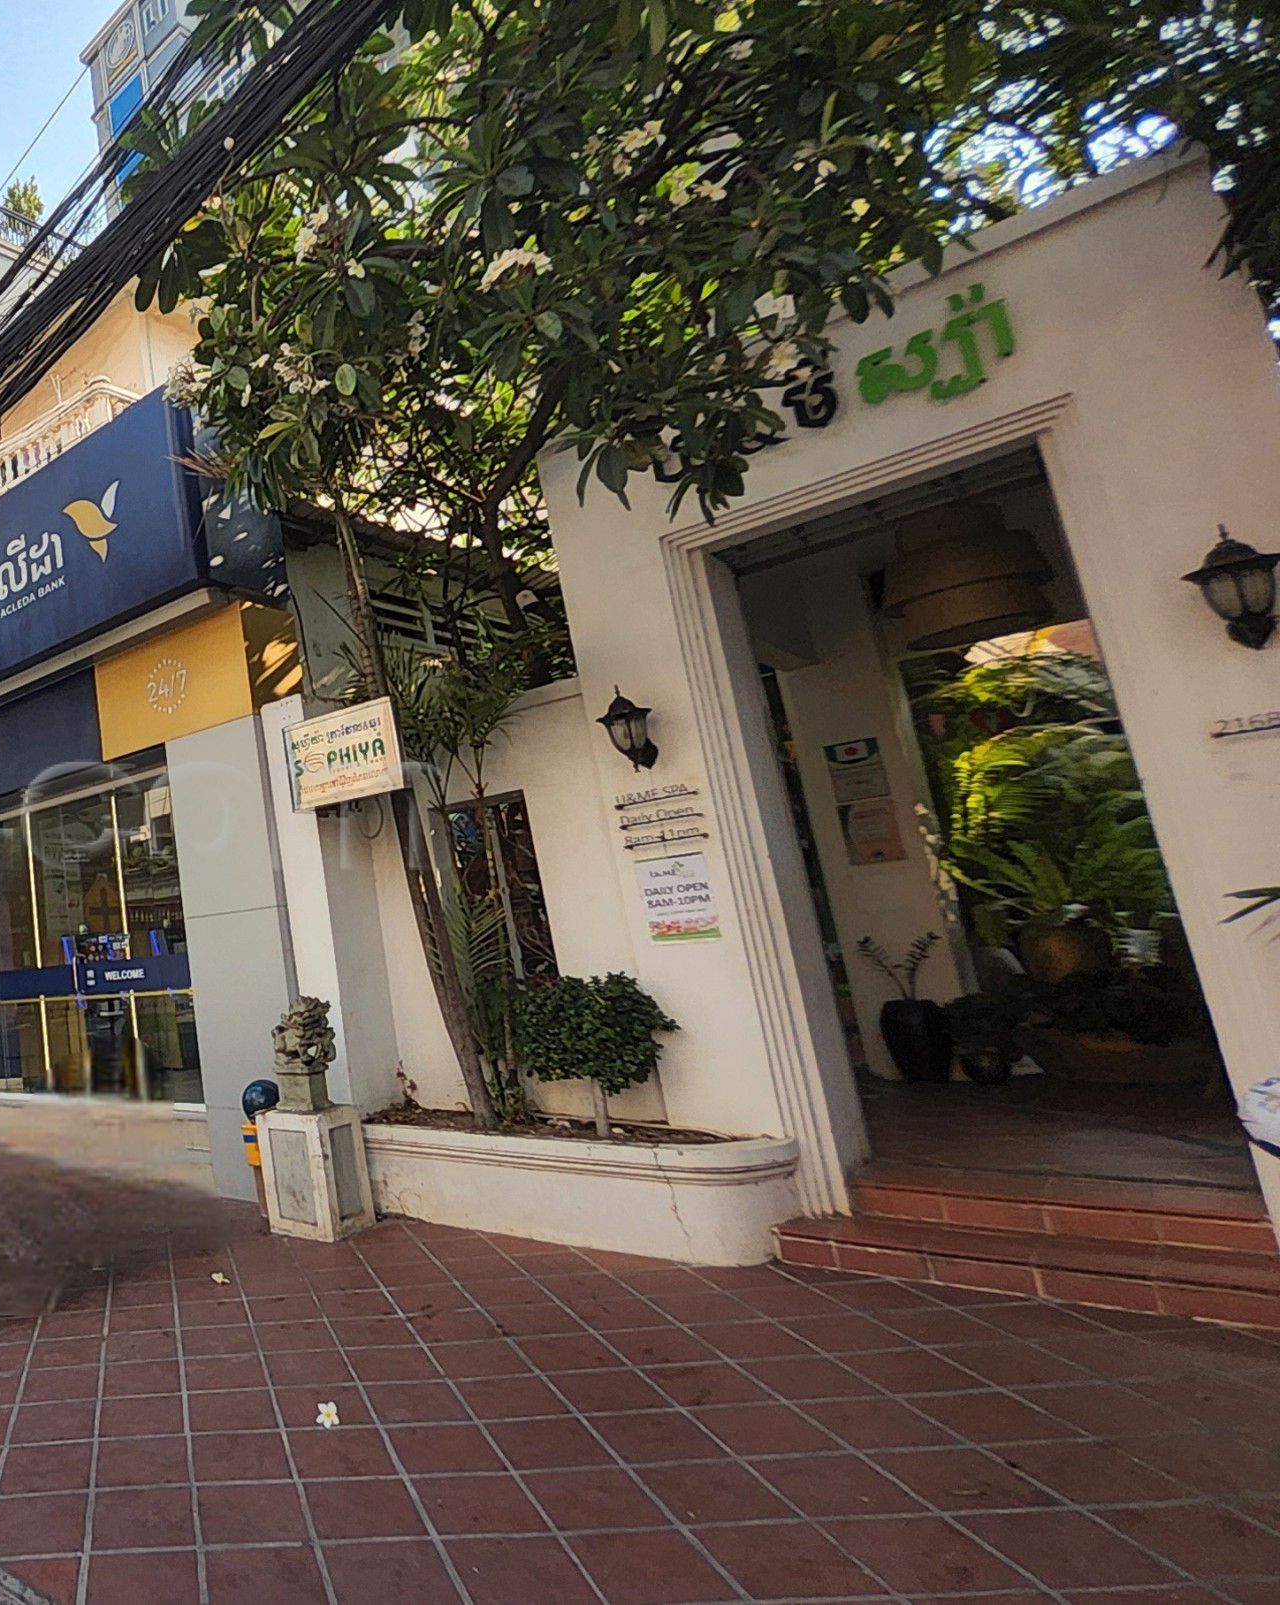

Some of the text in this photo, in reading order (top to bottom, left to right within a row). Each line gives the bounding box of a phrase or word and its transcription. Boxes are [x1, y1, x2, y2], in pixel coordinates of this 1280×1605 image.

[0, 575, 66, 619] ACLEDA BANK
[147, 668, 188, 703] 24/7
[644, 881, 710, 897] DAILY OPEN
[104, 968, 146, 982] WELCOME
